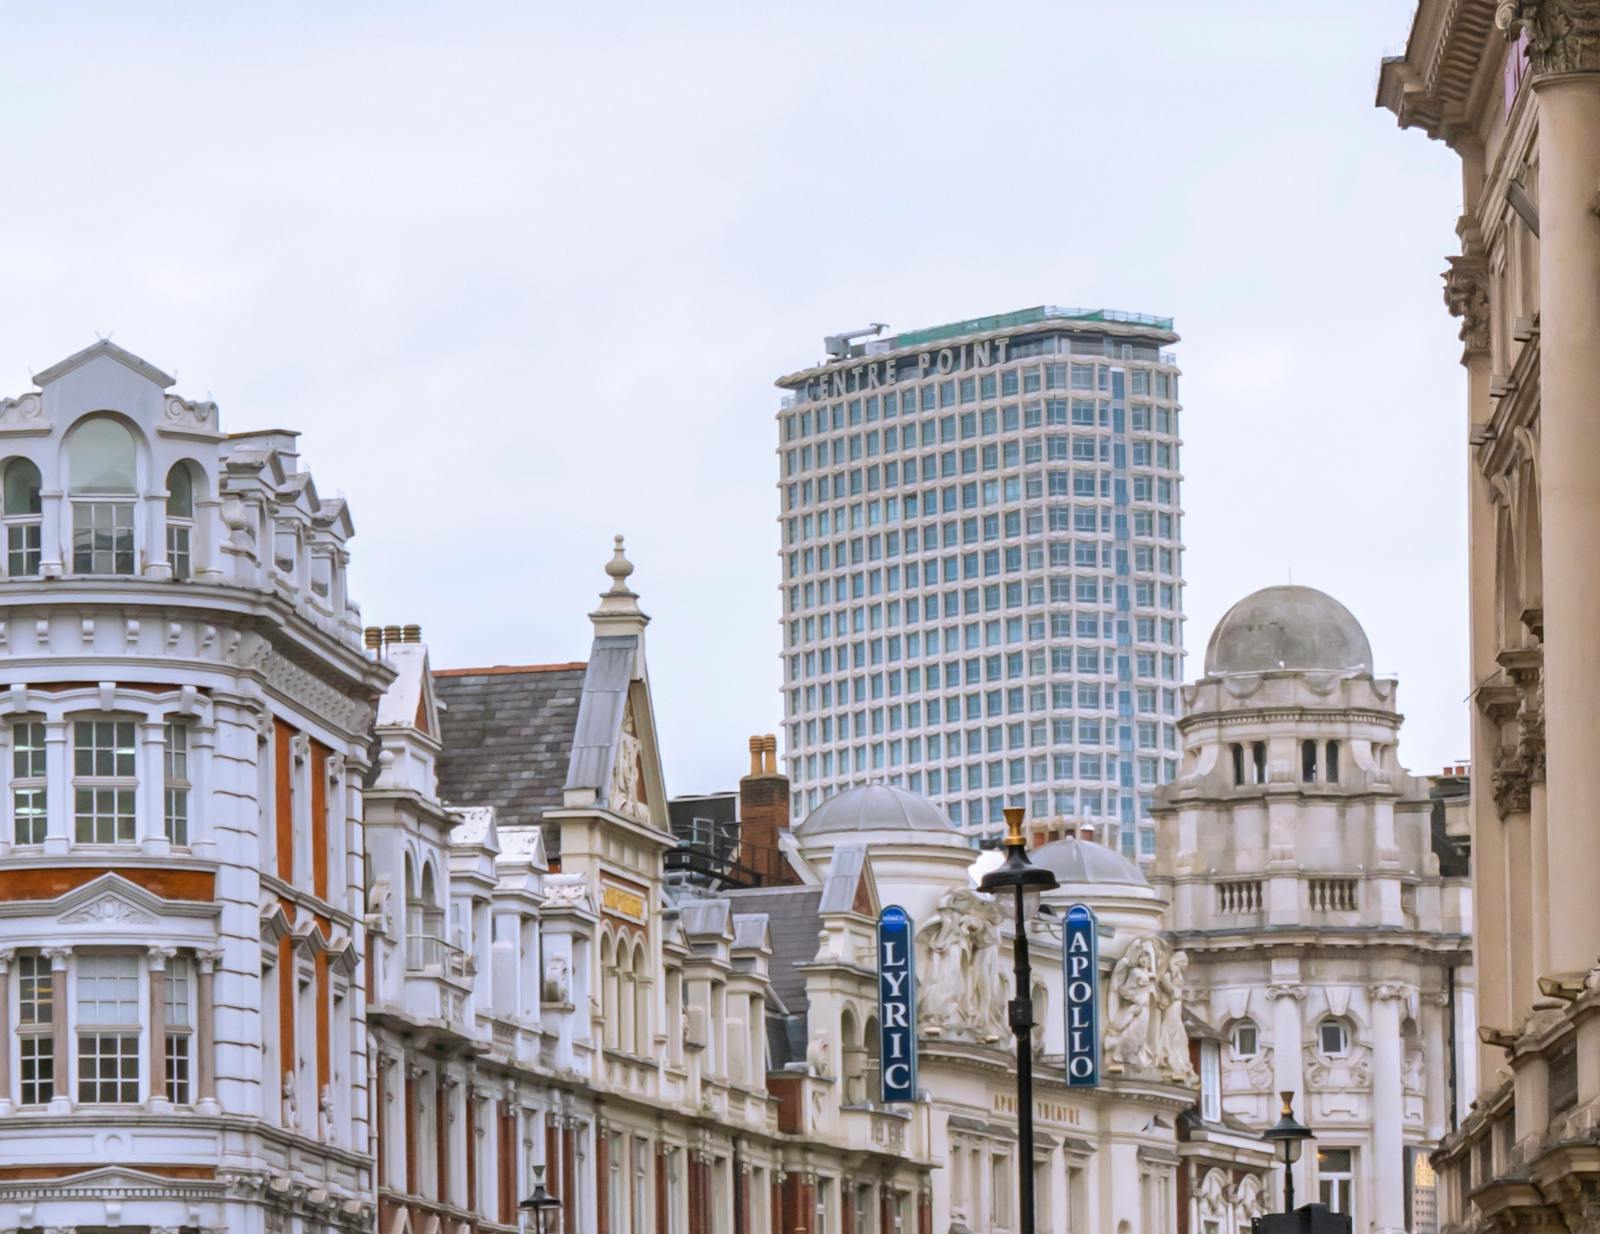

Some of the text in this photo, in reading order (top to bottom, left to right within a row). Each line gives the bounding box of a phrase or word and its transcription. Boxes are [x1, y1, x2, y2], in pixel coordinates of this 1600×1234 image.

[804, 337, 1010, 401] CENTRE POINT
[882, 941, 910, 1090] LYRIC
[1068, 931, 1094, 1078] APOLLO
